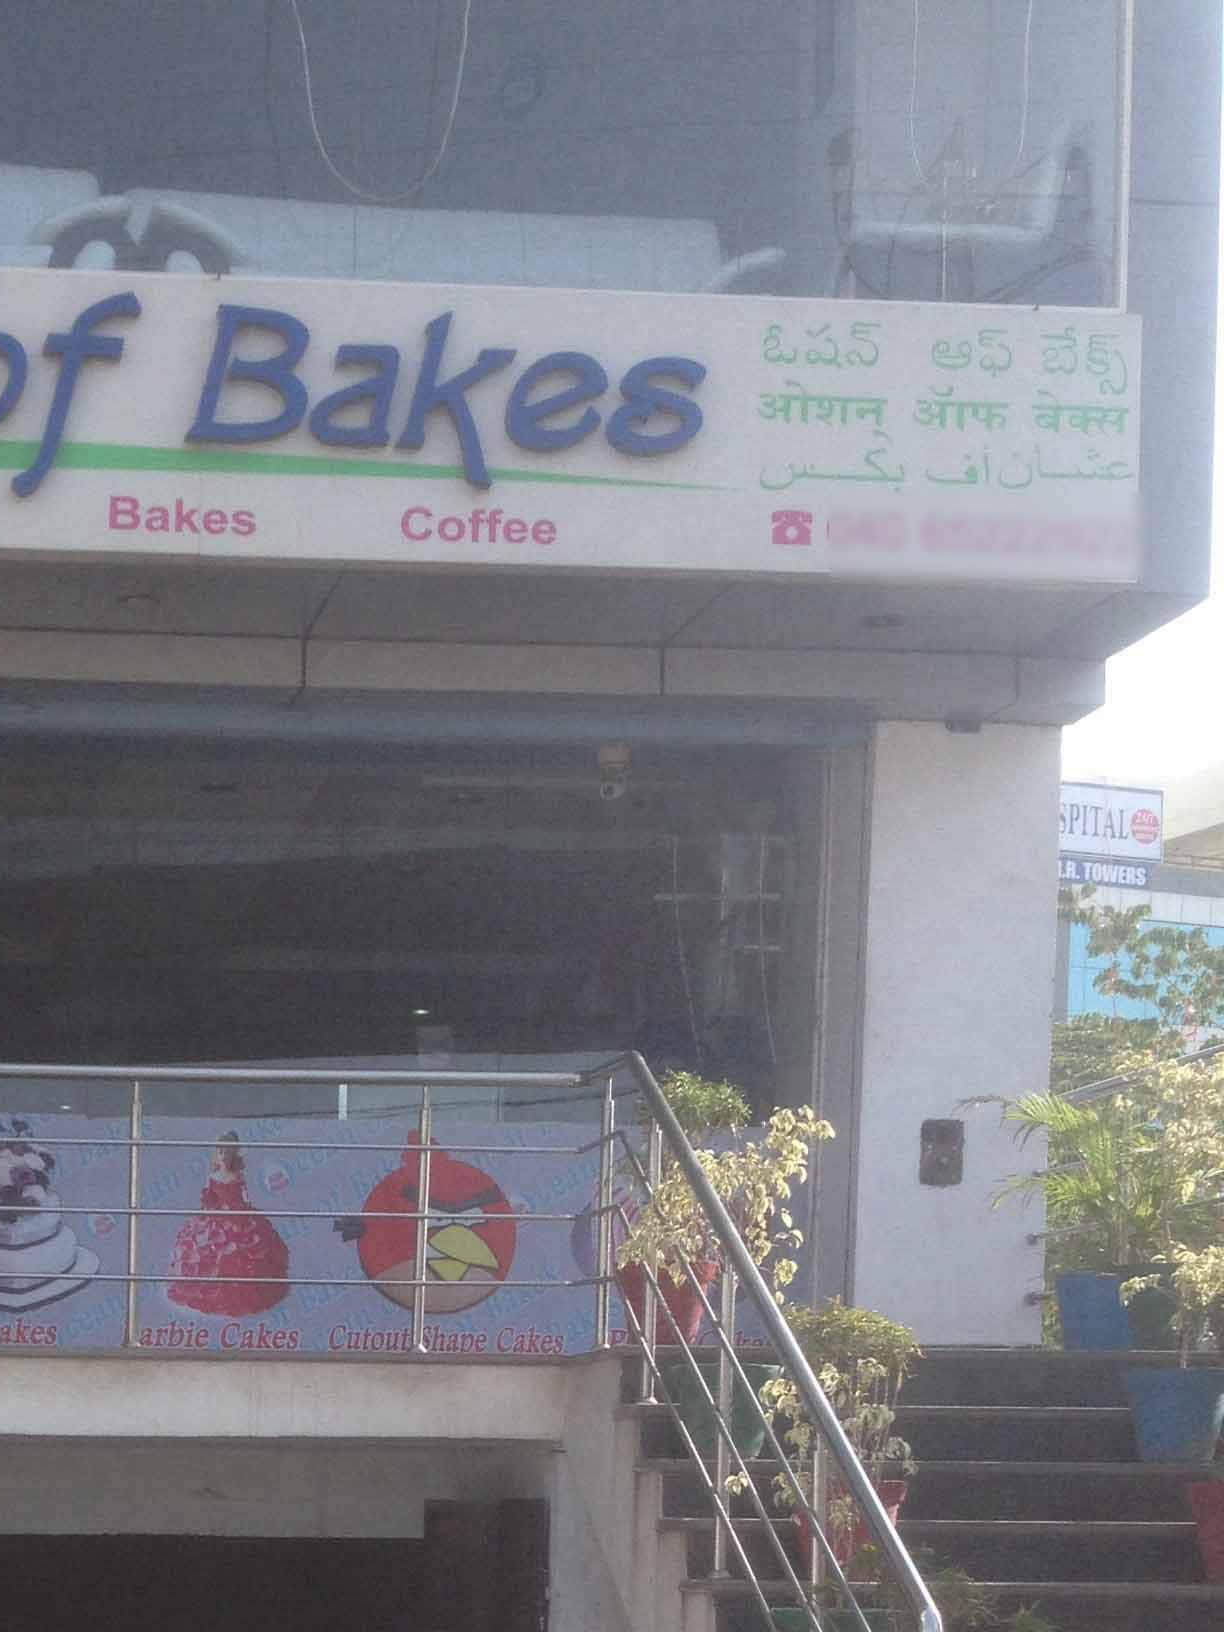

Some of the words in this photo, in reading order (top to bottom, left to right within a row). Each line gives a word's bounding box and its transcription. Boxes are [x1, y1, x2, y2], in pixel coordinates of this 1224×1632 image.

[184, 303, 708, 490] Bakes
[107, 495, 257, 536] Bakes
[400, 506, 559, 546] Coffee
[1083, 863, 1147, 886] TOWERS
[220, 1322, 300, 1351] Cakes
[327, 1324, 413, 1352] Cutout
[496, 1327, 565, 1354] Cakes
